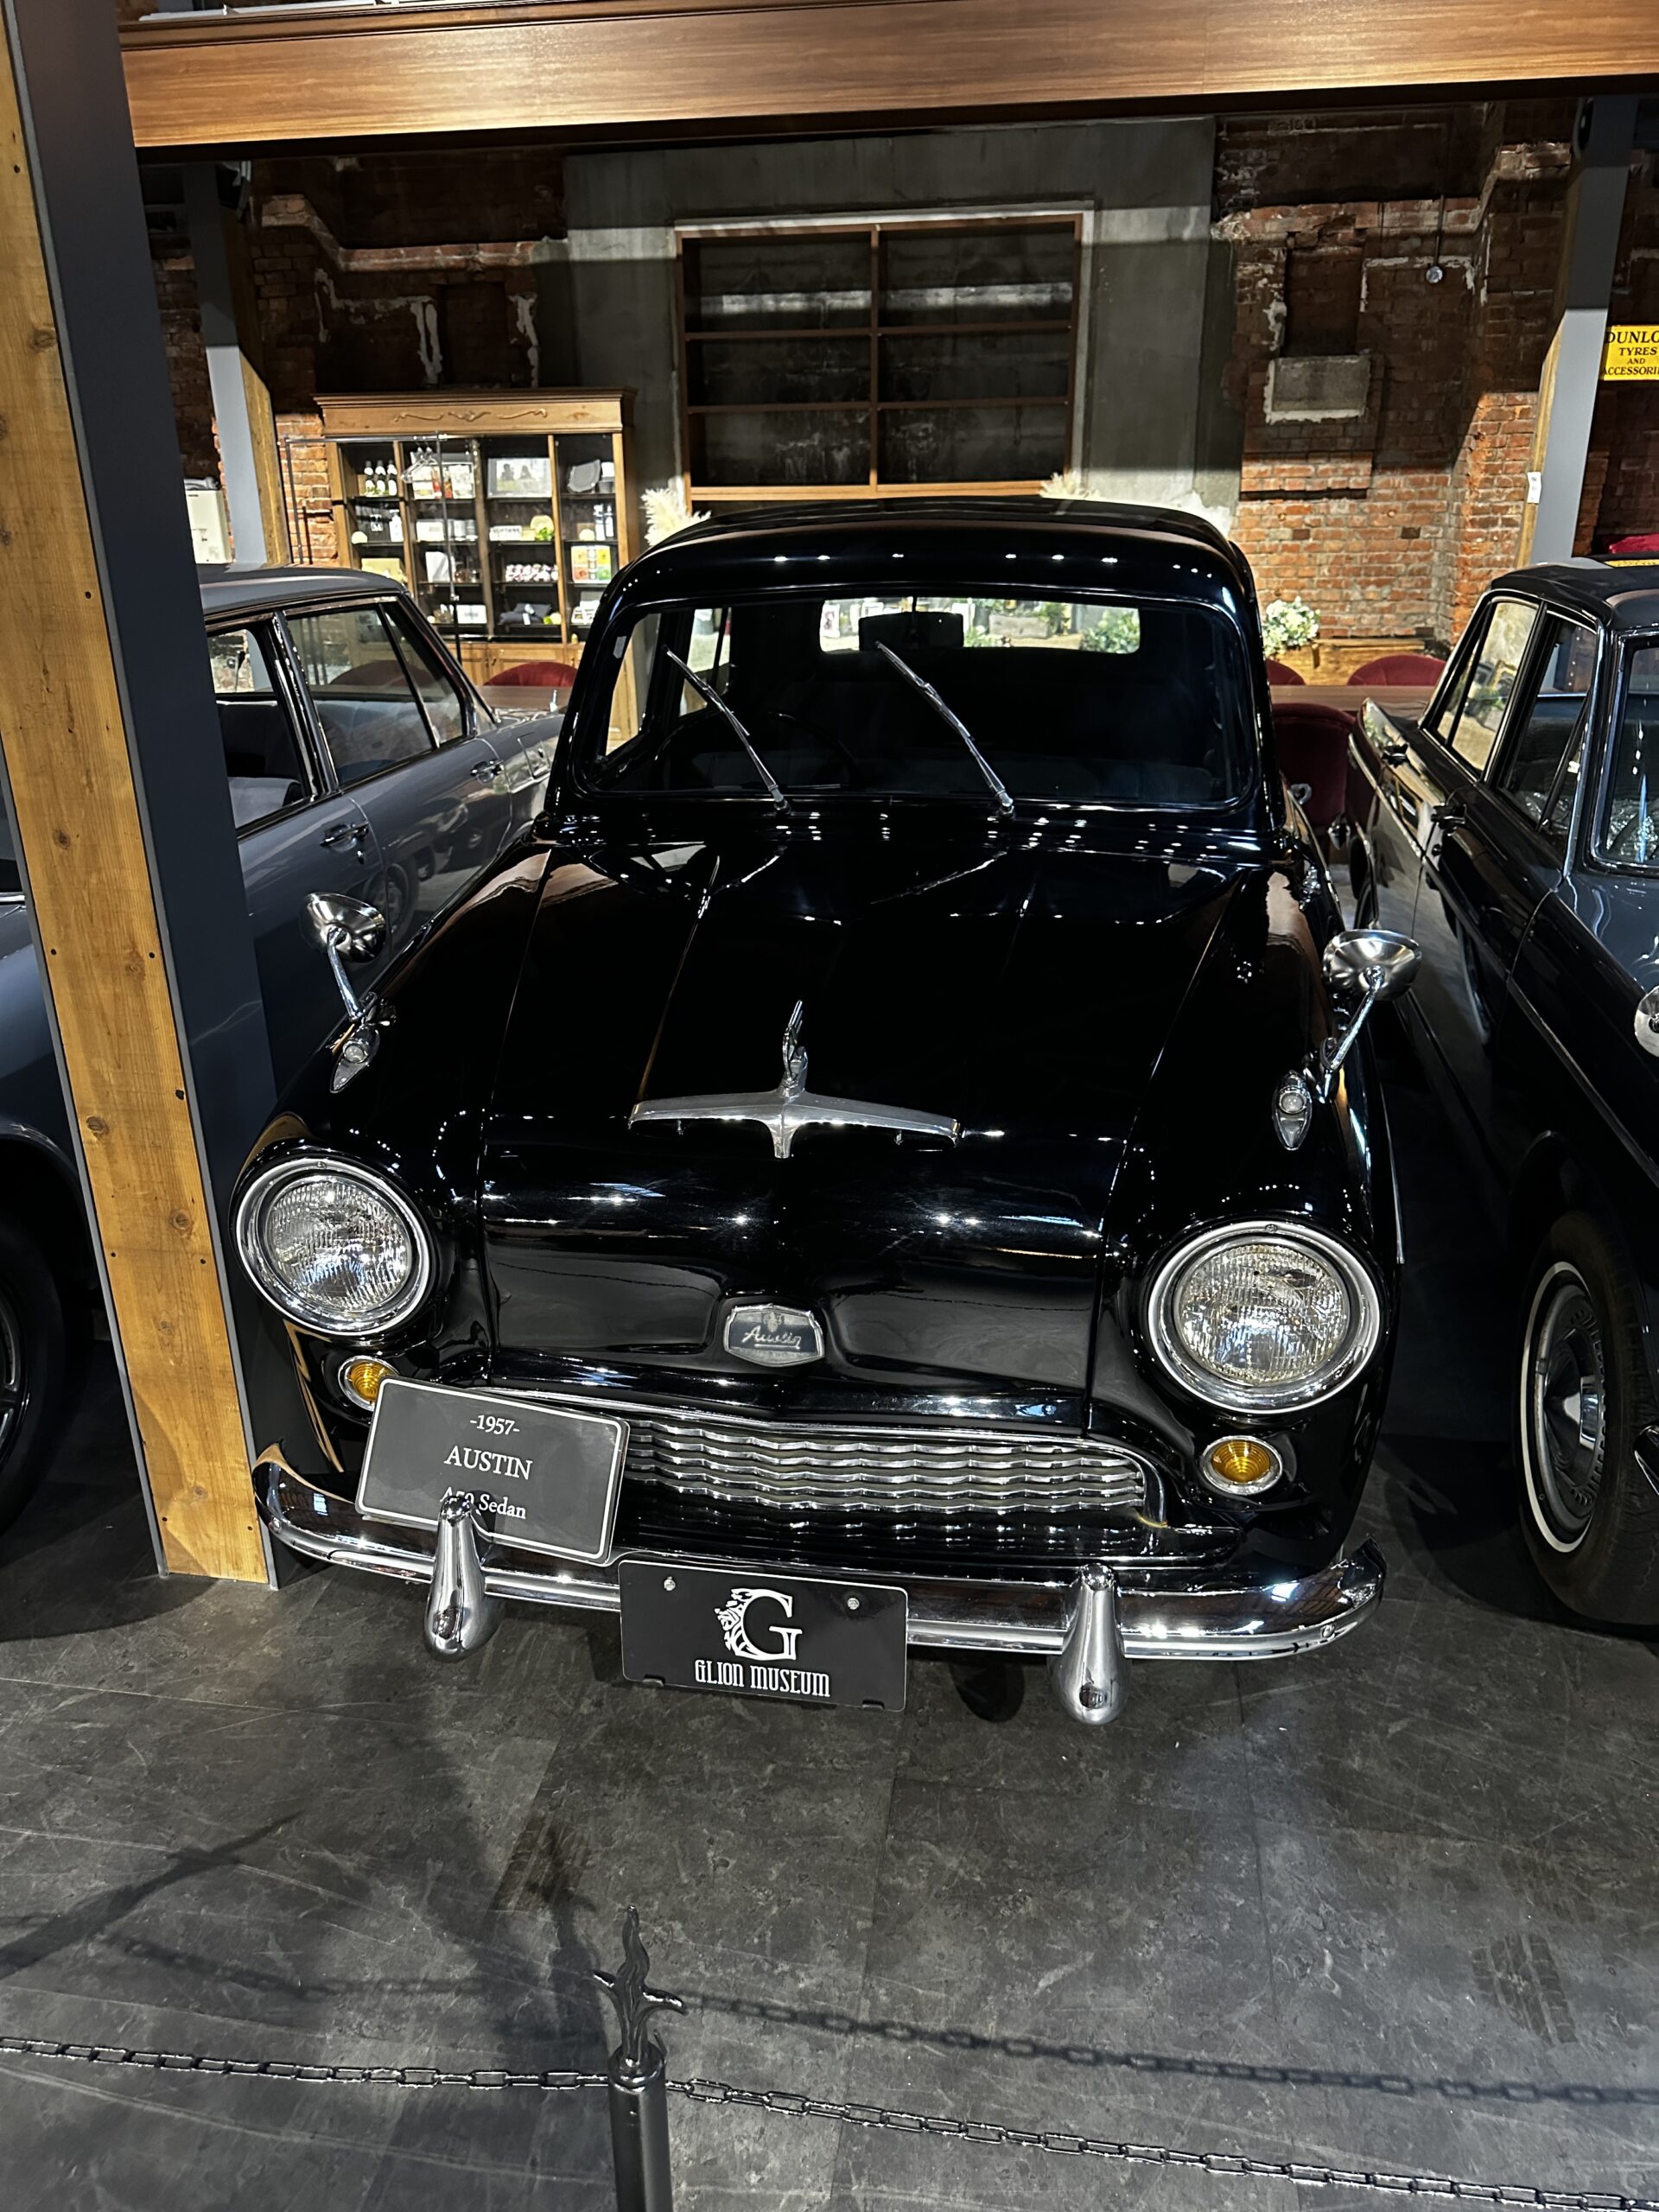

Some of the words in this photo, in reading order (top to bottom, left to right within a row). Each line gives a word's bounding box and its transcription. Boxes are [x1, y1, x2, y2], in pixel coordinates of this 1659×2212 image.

[1618, 346, 1658, 356] TYRES
[469, 1414, 520, 1435] -1957-
[443, 1445, 533, 1480] AUSTIN
[479, 1493, 526, 1519] Sedan
[694, 1659, 745, 1688] GLION
[750, 1665, 830, 1697] MUSEUM
